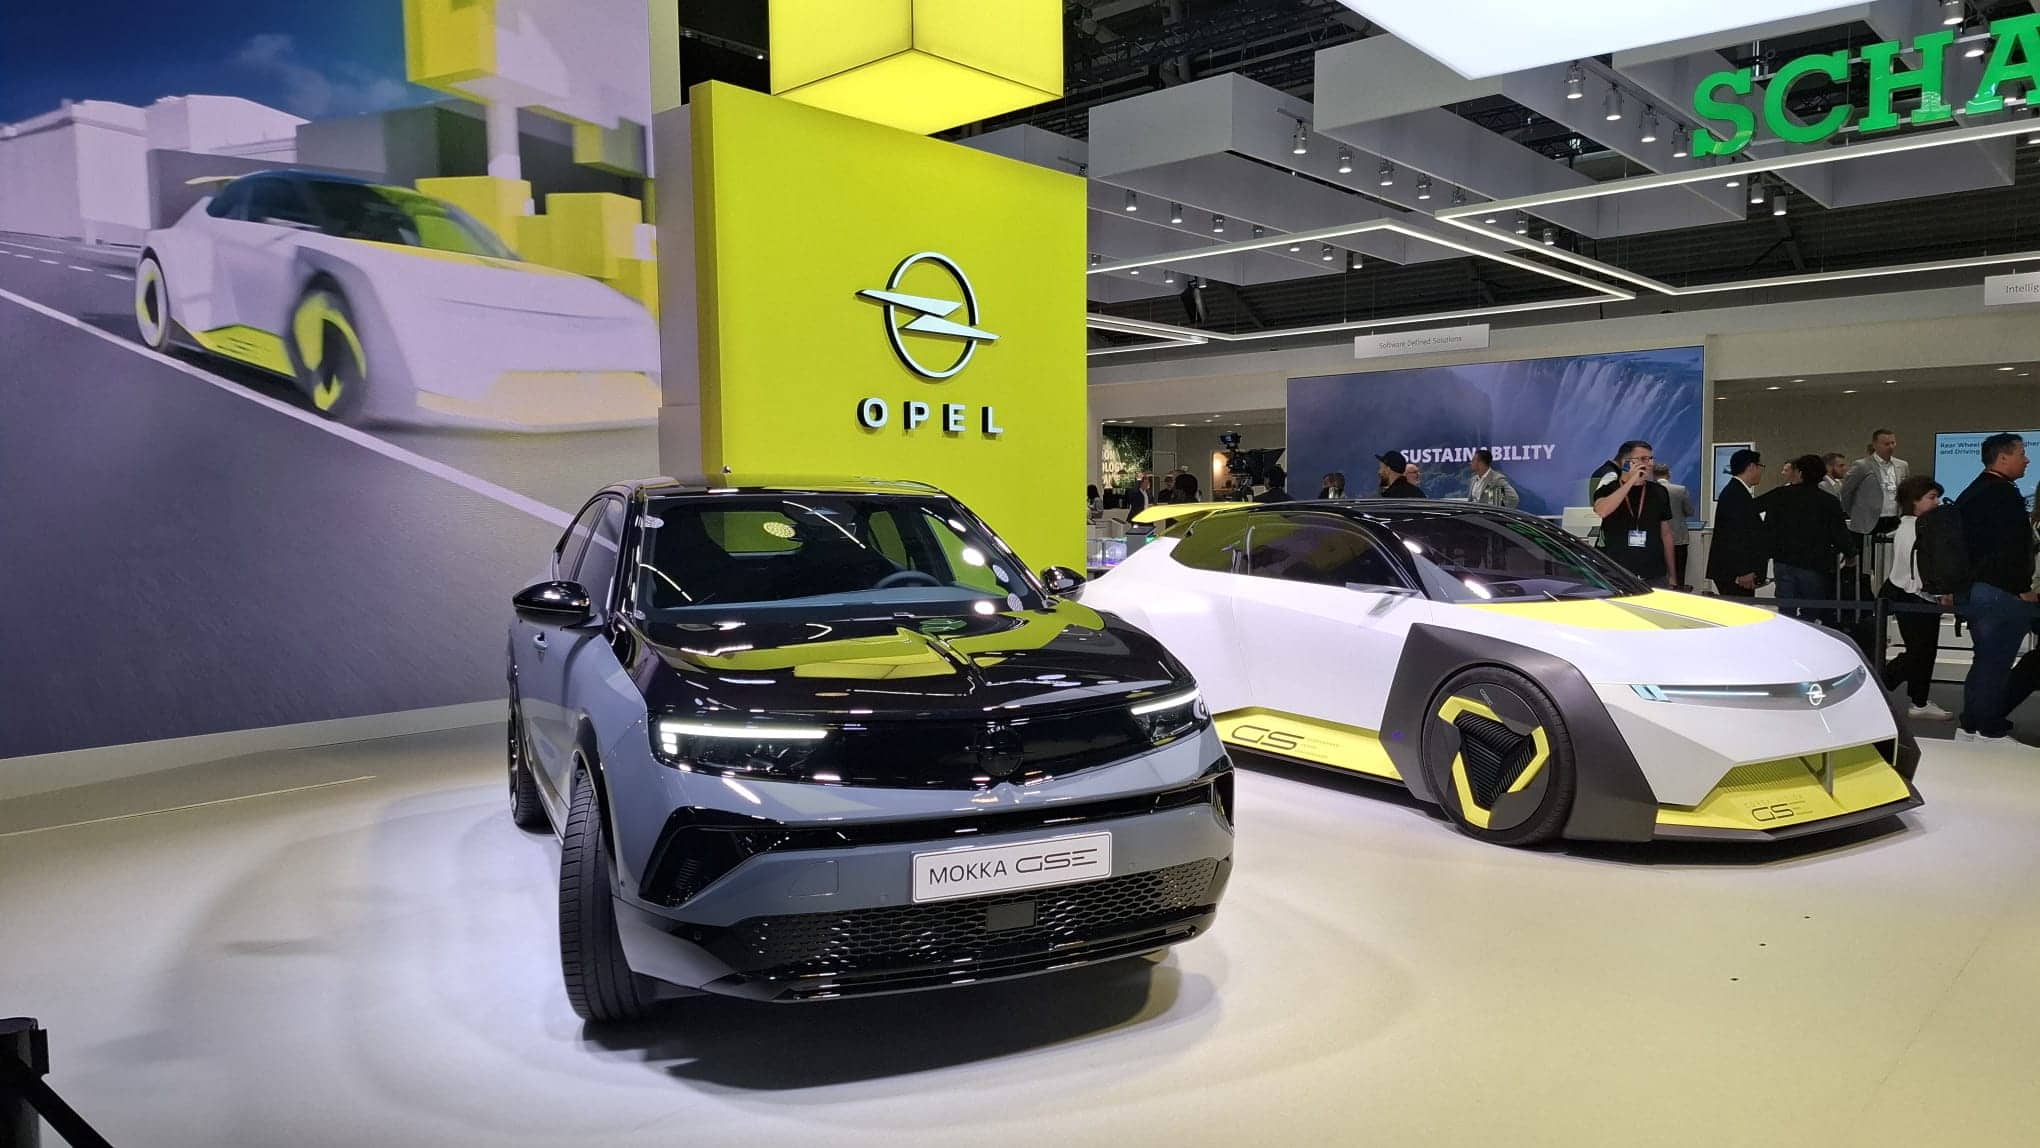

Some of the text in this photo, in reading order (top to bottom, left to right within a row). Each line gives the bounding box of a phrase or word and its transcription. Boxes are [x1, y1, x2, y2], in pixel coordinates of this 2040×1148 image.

[1692, 13, 2040, 158] SCHA
[1379, 335, 1463, 349] Software Defined Solutions
[857, 397, 1004, 434] OPEL
[1400, 445, 1556, 463] SUSTAINBILITY
[929, 848, 1098, 885] MOKKA GSE
